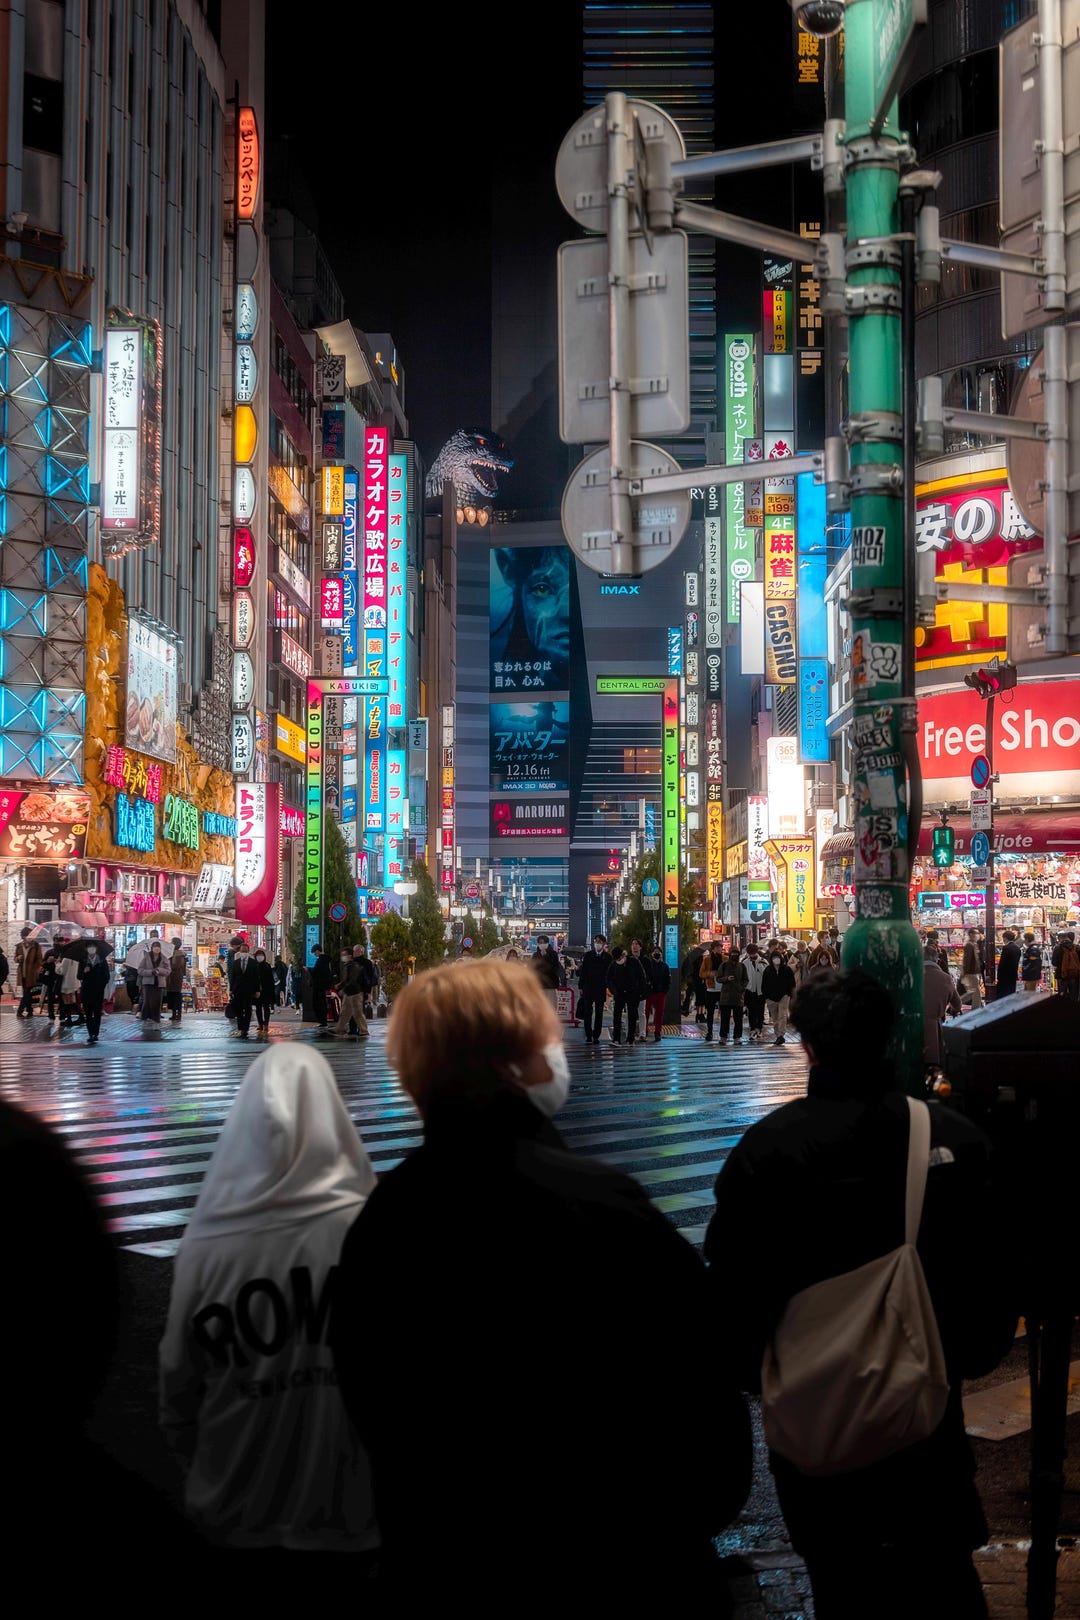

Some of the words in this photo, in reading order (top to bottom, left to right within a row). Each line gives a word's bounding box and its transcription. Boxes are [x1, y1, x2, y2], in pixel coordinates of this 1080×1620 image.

[800, 222, 821, 375] ドキホーテ
[114, 490, 127, 505] 光
[708, 485, 718, 510] ooth
[366, 434, 385, 598] カラオケ歌広場
[772, 518, 791, 530] 4F
[709, 521, 717, 564] ネットカフェ
[853, 528, 884, 546] MOZ
[769, 533, 794, 579] 麻雀
[601, 585, 640, 594] IMAX
[709, 578, 717, 607] カプセル
[768, 581, 789, 589] スリー
[766, 605, 797, 680] CASINO
[494, 660, 552, 673] 奪われるのは
[707, 654, 721, 692] Booth
[234, 725, 248, 758] かっぱ
[494, 731, 567, 752] アバター
[779, 745, 795, 756] 365
[923, 721, 986, 759] Free
[308, 713, 321, 822] GODZILLA
[370, 750, 380, 771] Shop
[708, 737, 722, 779] 甘太郎
[370, 771, 380, 788] Free
[507, 763, 538, 776] 12.16
[540, 767, 551, 775] fri
[370, 788, 380, 804] Tax
[709, 784, 721, 792] 4F
[709, 792, 721, 800] 3F
[665, 727, 678, 873] ゴジラロード
[239, 789, 255, 854] トラノコ
[515, 804, 566, 819] MARUHAN
[823, 817, 833, 826] 36
[780, 844, 812, 853] カラオケ
[308, 833, 321, 890] ROAD
[1005, 881, 1066, 899] 歌舞伎町店
